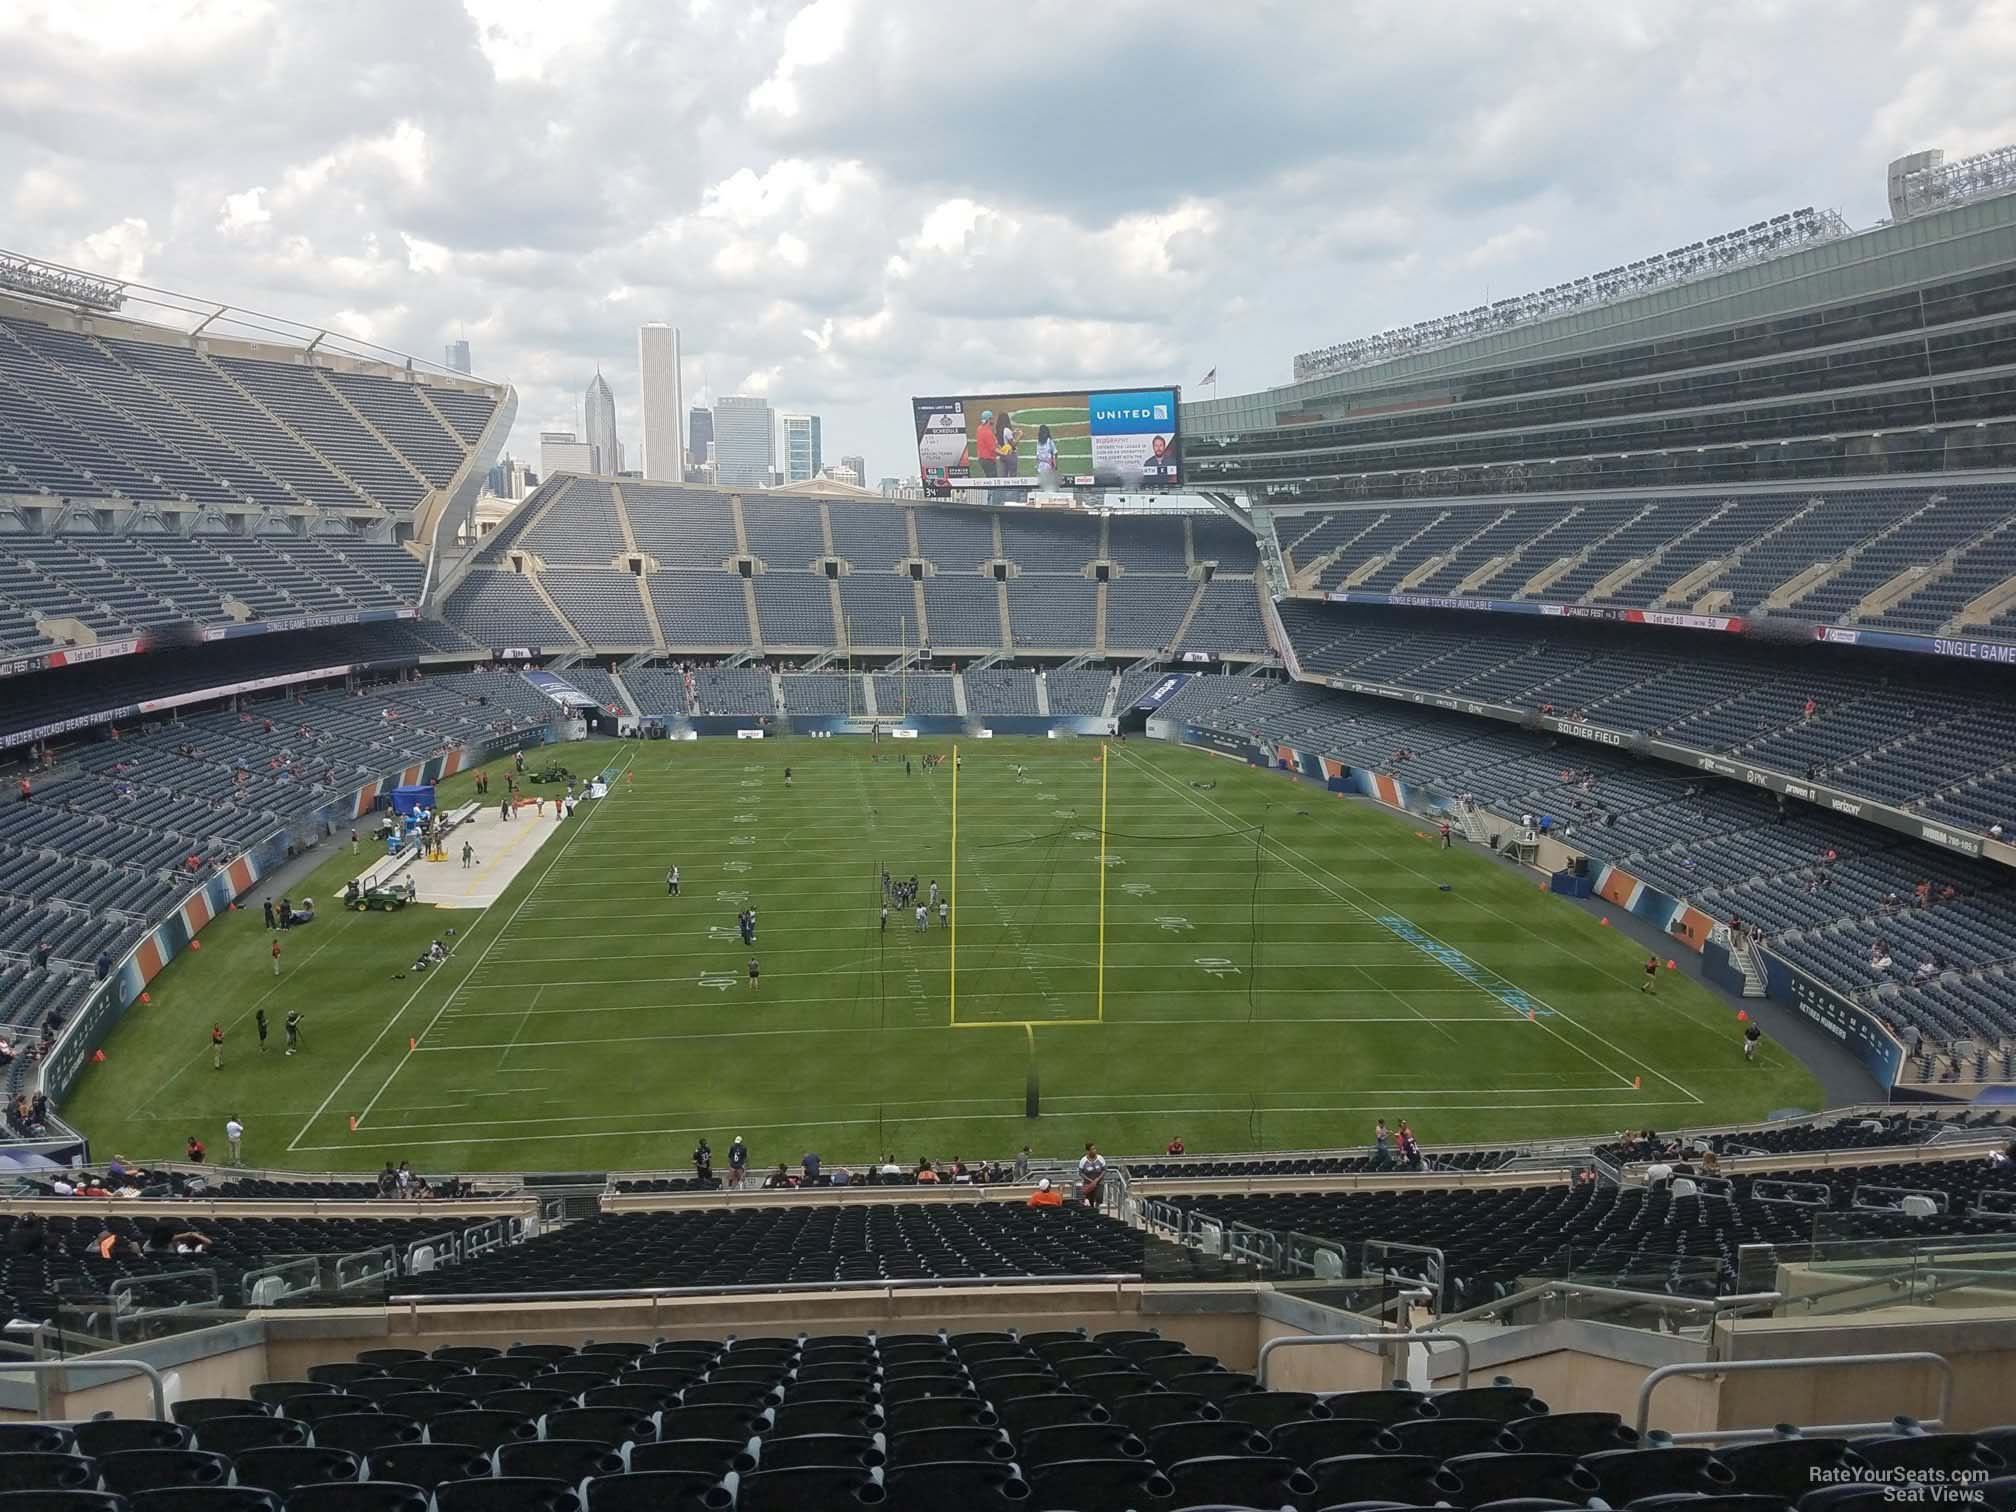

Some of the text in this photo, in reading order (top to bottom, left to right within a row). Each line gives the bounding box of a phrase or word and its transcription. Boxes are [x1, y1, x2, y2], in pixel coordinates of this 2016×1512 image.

[1096, 409, 1151, 420] UNITED
[1457, 600, 1493, 611] AVAILABLE
[266, 620, 288, 633] SINGLE
[289, 618, 305, 630] GAME
[330, 614, 360, 626] AVAILABLE
[1933, 638, 2016, 663] SINGLE GAME
[14, 660, 28, 673] FEST
[5, 731, 33, 747] MEIJER
[34, 721, 65, 739] CHICAGO
[66, 715, 89, 731] BEARS
[90, 710, 113, 725] FAMILY
[115, 706, 131, 719] FEST
[1558, 722, 1620, 746] SOLDIER FIELD
[1754, 773, 1769, 786] PNC
